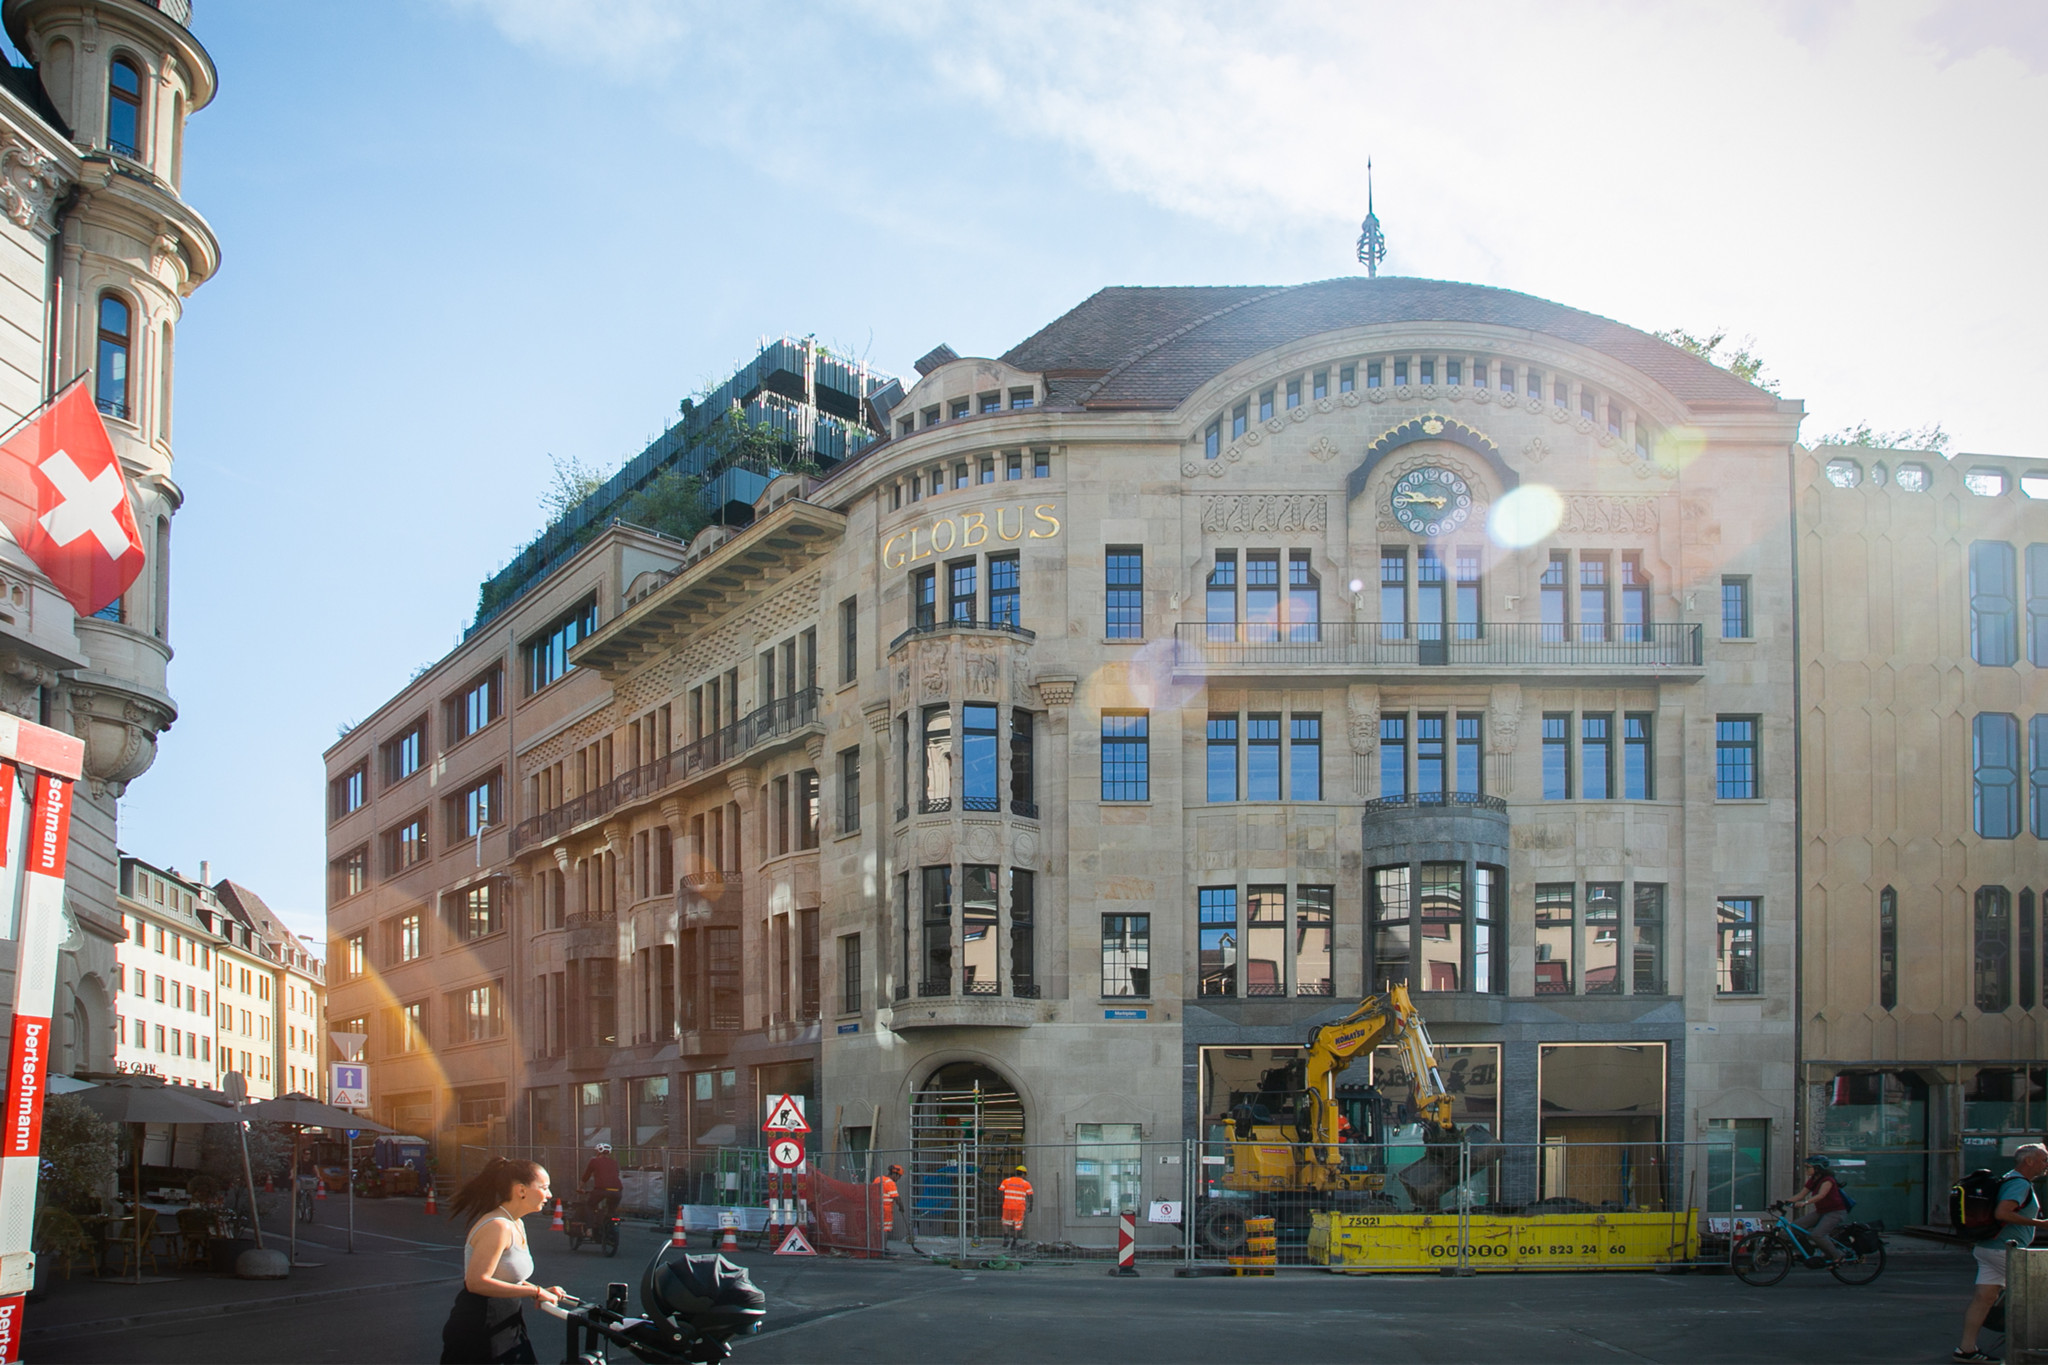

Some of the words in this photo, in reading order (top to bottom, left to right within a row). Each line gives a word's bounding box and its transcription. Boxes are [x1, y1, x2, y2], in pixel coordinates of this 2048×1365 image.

[1411, 473, 1420, 483] 11
[1427, 470, 1437, 479] 12
[1445, 473, 1450, 483] 1
[1399, 483, 1411, 494] 10
[1455, 482, 1463, 494] 2
[1400, 510, 1410, 521] 8
[1454, 509, 1464, 521] 4
[1412, 521, 1421, 531] 7
[1427, 523, 1438, 535] 6
[883, 504, 1061, 570] GLOBUS
[42, 775, 64, 869] schmann
[1335, 1029, 1365, 1044] KOMATSU
[16, 1023, 43, 1151] bertschmann
[1349, 1217, 1380, 1226] 75021
[1519, 1245, 1542, 1255] 061
[1549, 1245, 1573, 1255] 823
[1581, 1245, 1597, 1254] 24
[1609, 1245, 1626, 1254] 60
